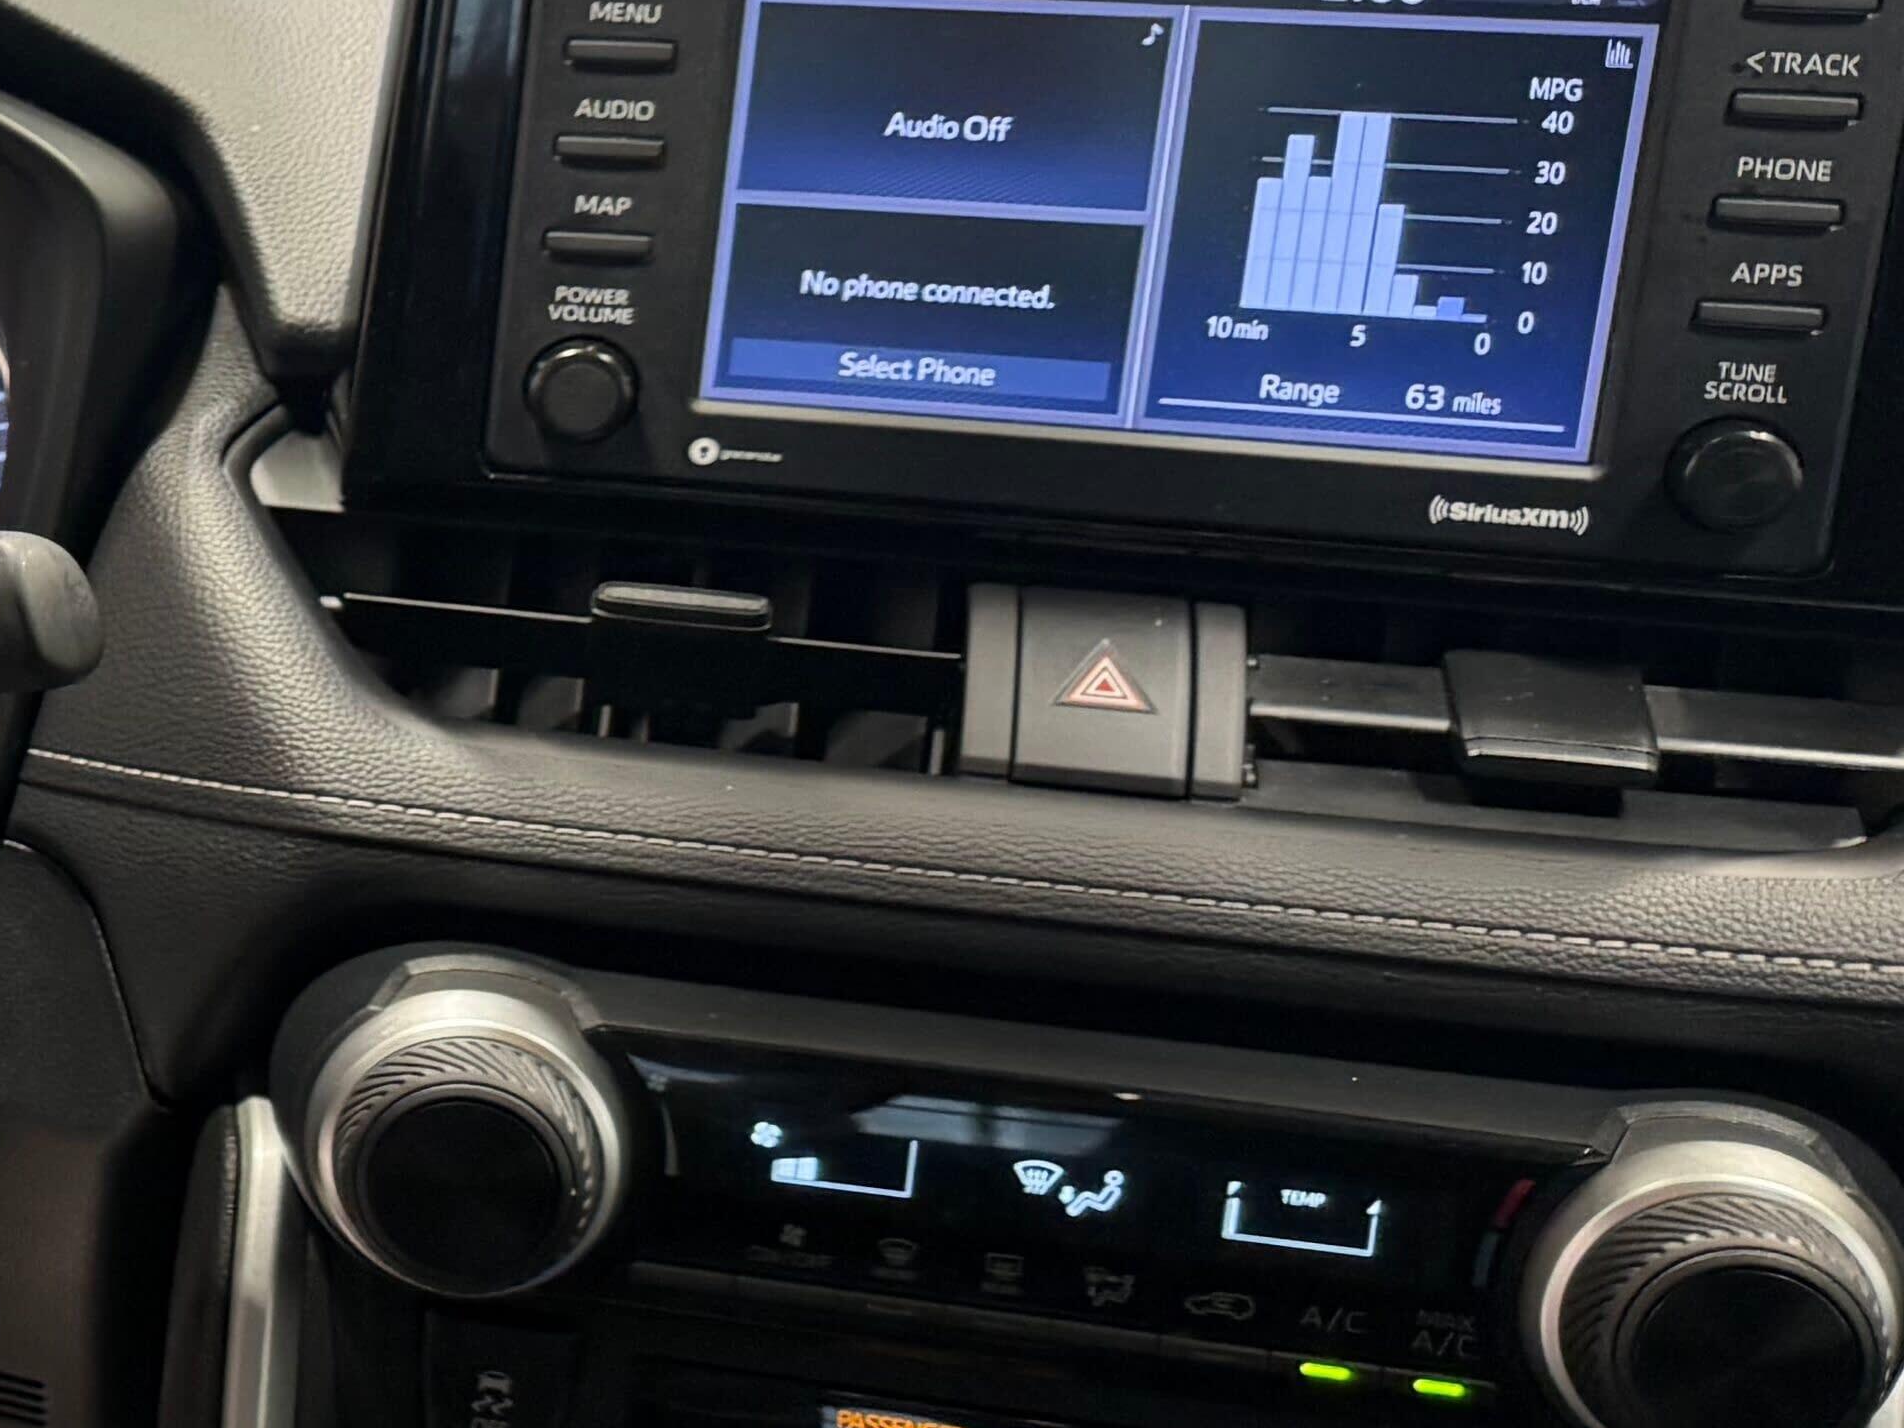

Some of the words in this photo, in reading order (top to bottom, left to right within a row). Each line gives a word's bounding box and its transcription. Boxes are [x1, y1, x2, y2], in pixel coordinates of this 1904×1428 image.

[589, 2, 662, 24] MENU
[1769, 51, 1861, 77] TRACK
[1529, 76, 1583, 103] MPG
[575, 99, 655, 121] AUDIO
[1541, 110, 1574, 135] 40
[884, 111, 960, 142] Audio
[963, 115, 1015, 143] Off
[1534, 161, 1566, 186] 30
[1736, 157, 1833, 182] PHONE
[575, 194, 632, 216] MAP
[1526, 211, 1558, 236] 20
[1521, 261, 1548, 285] 10
[1730, 262, 1803, 286] APPS
[555, 285, 629, 305] POWER
[801, 269, 839, 297] No
[842, 272, 919, 304] phone
[922, 279, 1056, 311] connected.
[548, 304, 635, 325] VOLUME
[1517, 312, 1534, 335] 0
[1206, 316, 1233, 340] 10
[1234, 319, 1269, 342] min
[1350, 325, 1366, 349] 5
[1473, 332, 1491, 357] 0
[839, 351, 912, 382] Select
[917, 357, 996, 387] Phone
[1718, 362, 1777, 383] TUNE
[1260, 373, 1340, 407] Range
[1405, 384, 1445, 410] 63
[1452, 391, 1501, 416] miles
[1704, 381, 1787, 405] SCROLL
[1300, 1305, 1369, 1335] A/C
